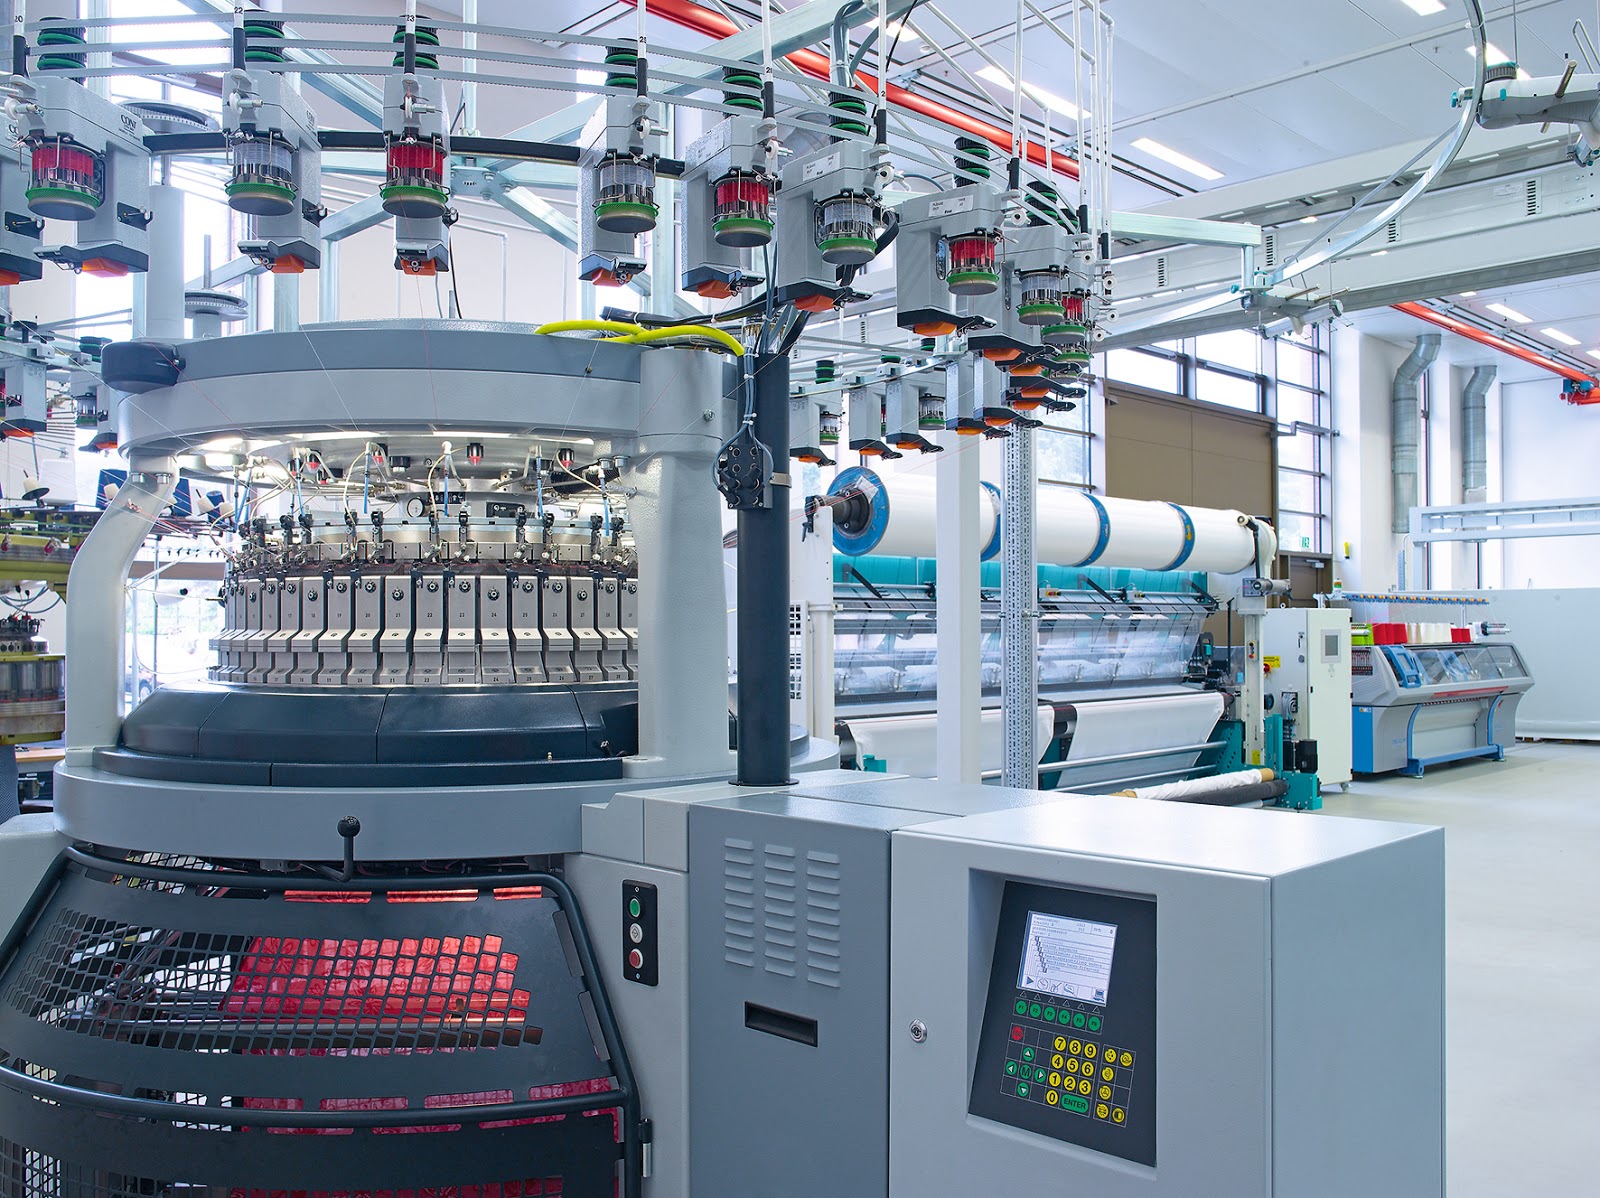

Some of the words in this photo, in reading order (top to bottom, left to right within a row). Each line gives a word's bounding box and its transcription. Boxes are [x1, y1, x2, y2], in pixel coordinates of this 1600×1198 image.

[407, 14, 414, 22] 23
[1058, 1038, 1064, 1048] 7
[1072, 1042, 1078, 1052] 8
[1087, 1045, 1094, 1056] 9
[1054, 1057, 1060, 1066] 4
[1069, 1060, 1076, 1070] 5
[1022, 1067, 1030, 1076] M
[1084, 1064, 1090, 1074] 6
[1052, 1074, 1057, 1084] 1
[1066, 1078, 1073, 1088] 2
[1082, 1082, 1088, 1092] 3
[1049, 1092, 1055, 1102] 0
[1064, 1098, 1086, 1110] ENTER
